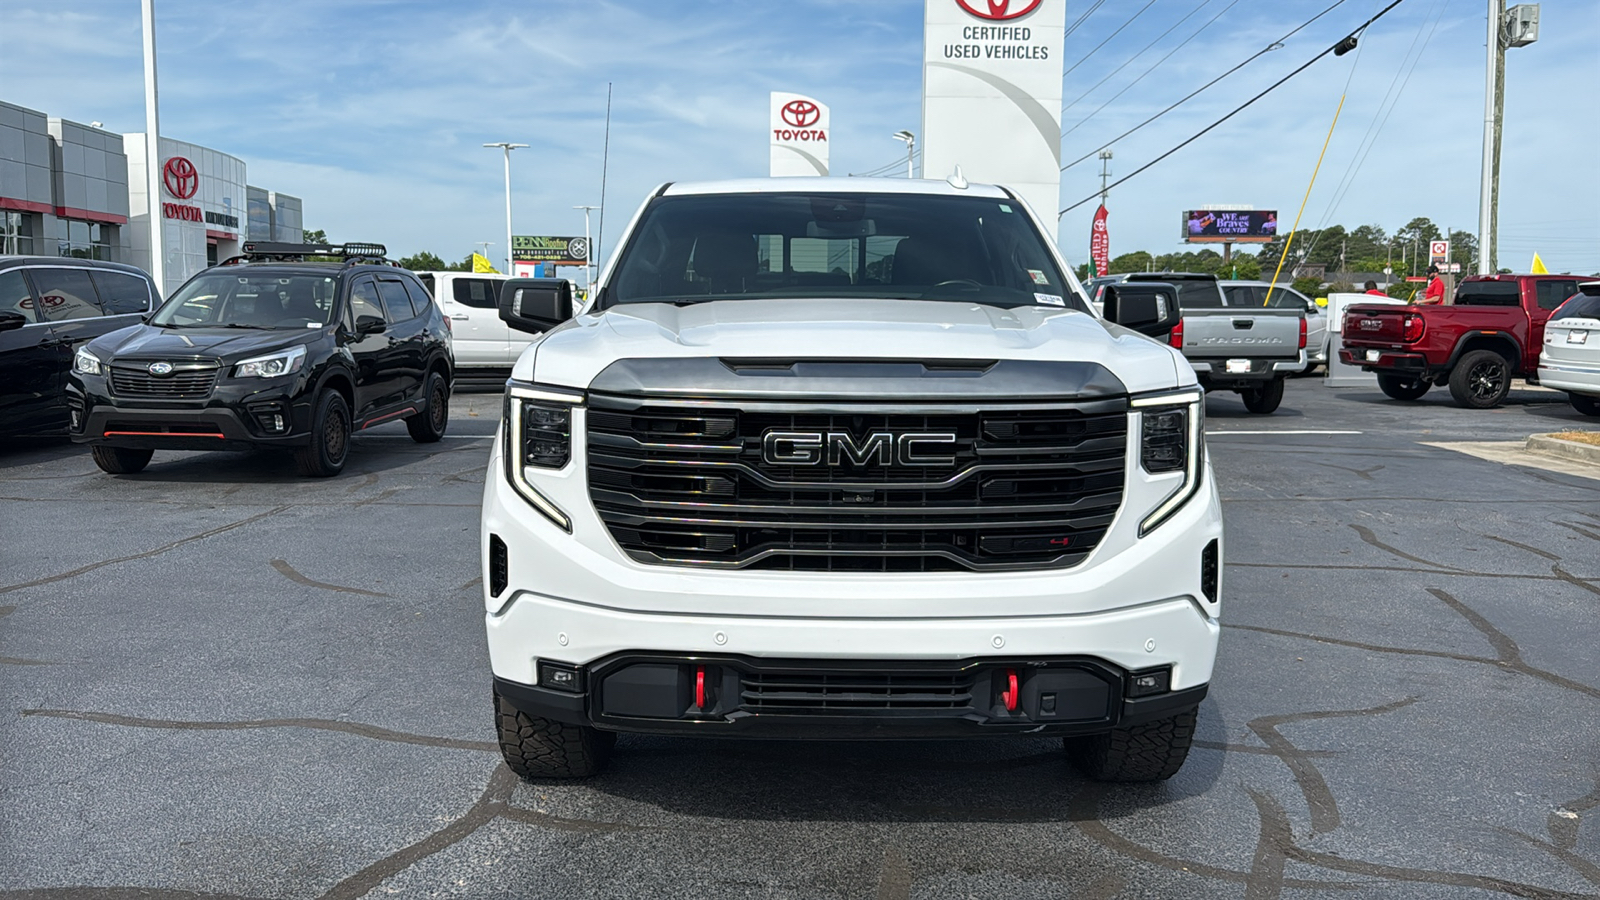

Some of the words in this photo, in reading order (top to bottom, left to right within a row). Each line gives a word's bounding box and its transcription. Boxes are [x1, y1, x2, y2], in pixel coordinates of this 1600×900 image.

[962, 26, 1031, 41] CERTIFIED
[944, 44, 981, 59] USED
[985, 45, 1049, 60] VEHICLES
[773, 129, 827, 142] TOYOTA
[1216, 218, 1250, 228] Braves
[1221, 213, 1237, 221] WE
[513, 237, 545, 247] PENN
[763, 431, 956, 467] GMC
